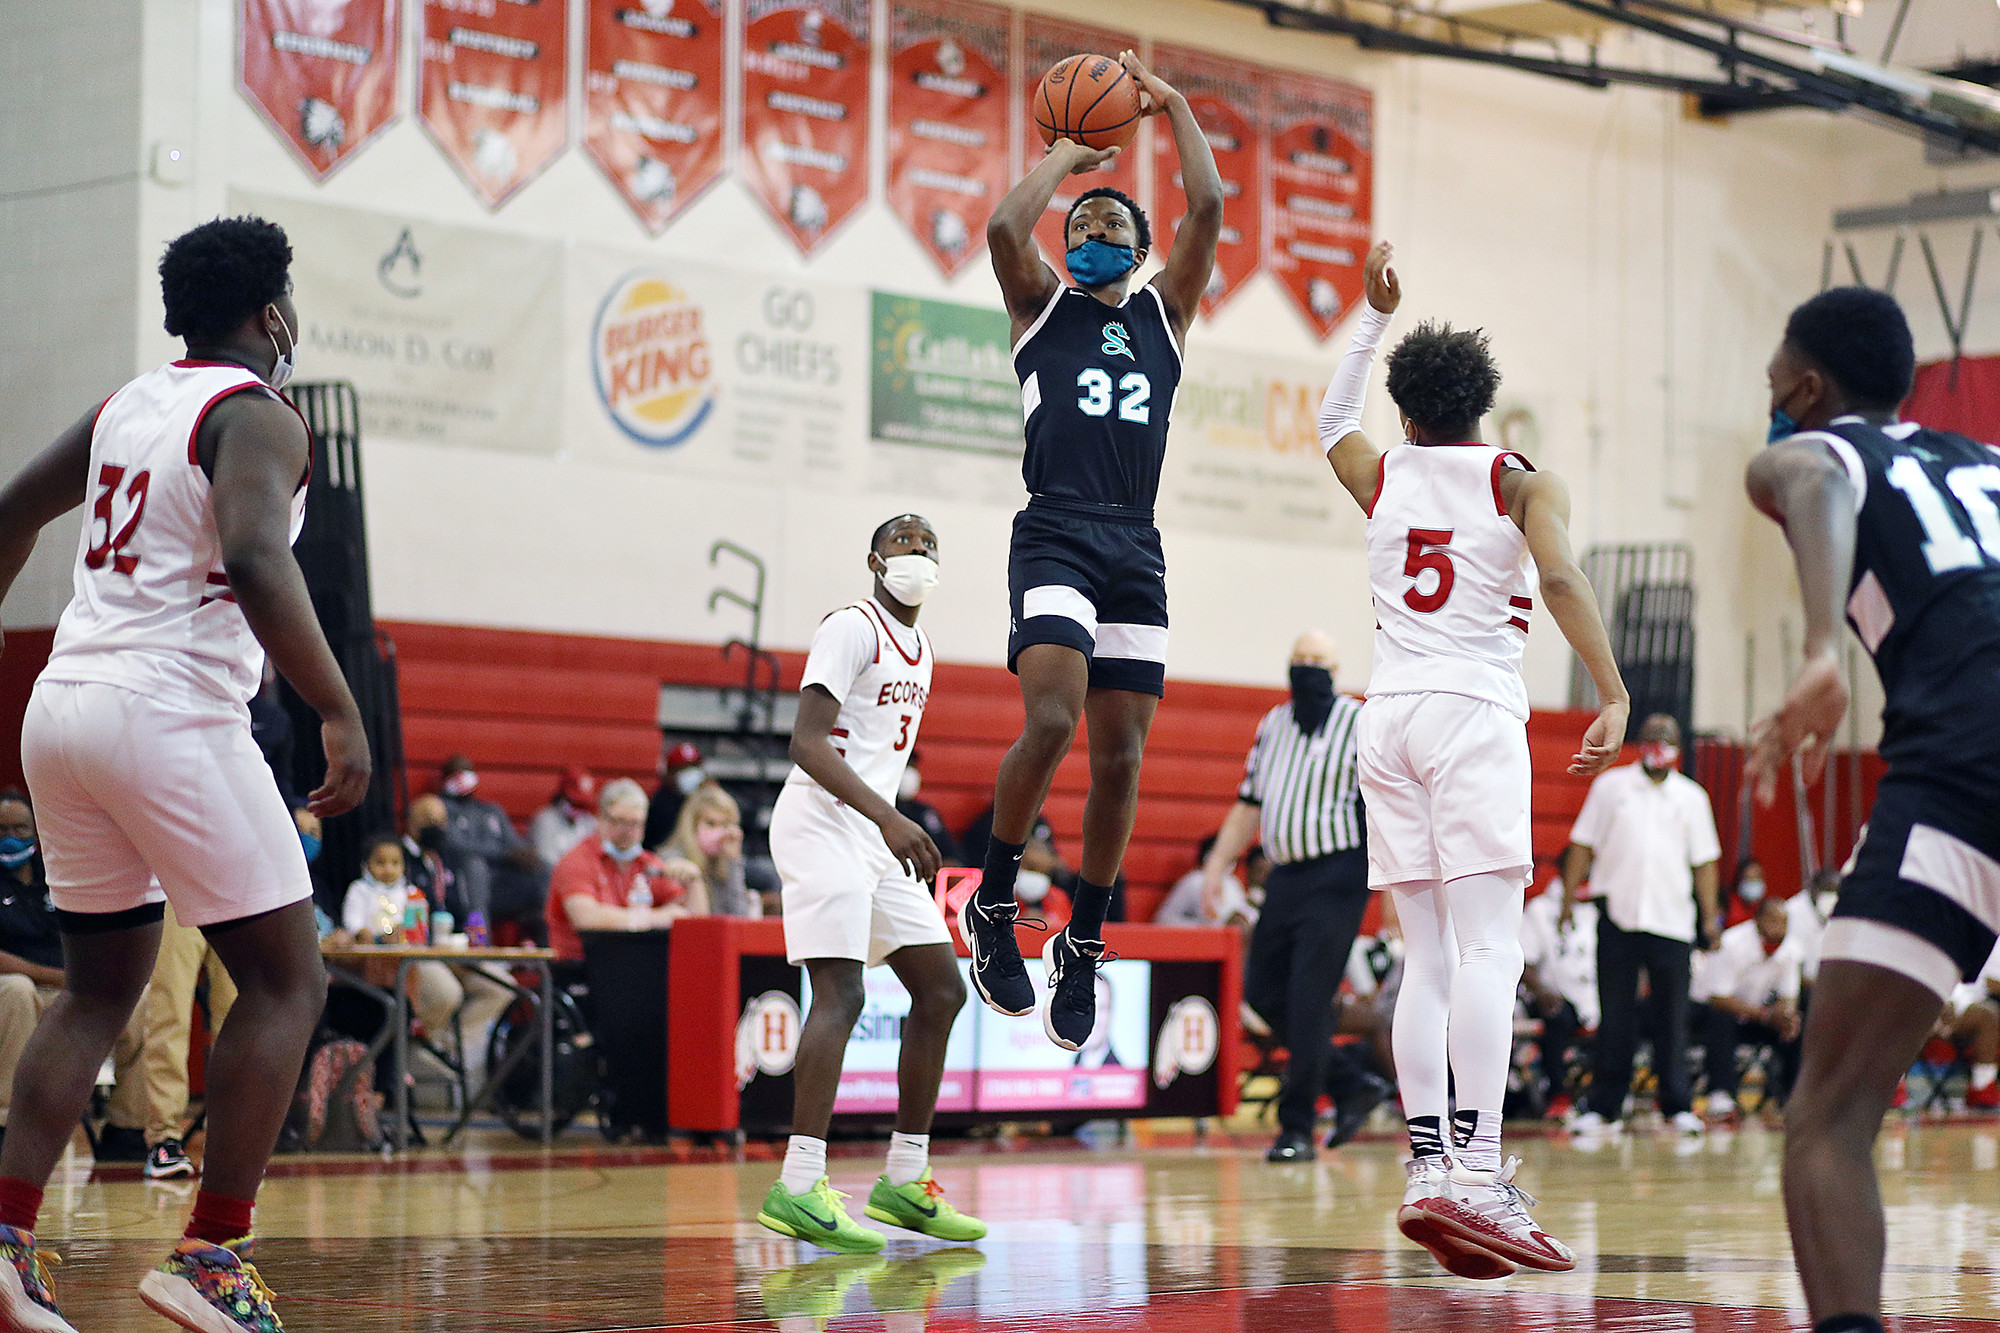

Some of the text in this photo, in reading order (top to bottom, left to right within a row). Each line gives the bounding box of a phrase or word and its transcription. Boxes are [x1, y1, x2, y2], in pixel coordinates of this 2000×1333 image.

[605, 303, 703, 357] BURGER
[762, 284, 816, 332] GO
[610, 340, 711, 408] KING
[735, 331, 842, 387] CHIEFS
[1076, 367, 1151, 425] 32
[1264, 379, 1331, 457] CA
[85, 461, 150, 577] 32
[1402, 526, 1457, 615] 5
[894, 714, 912, 752] 3
[763, 1011, 786, 1052] H
[1183, 1015, 1204, 1053] H
